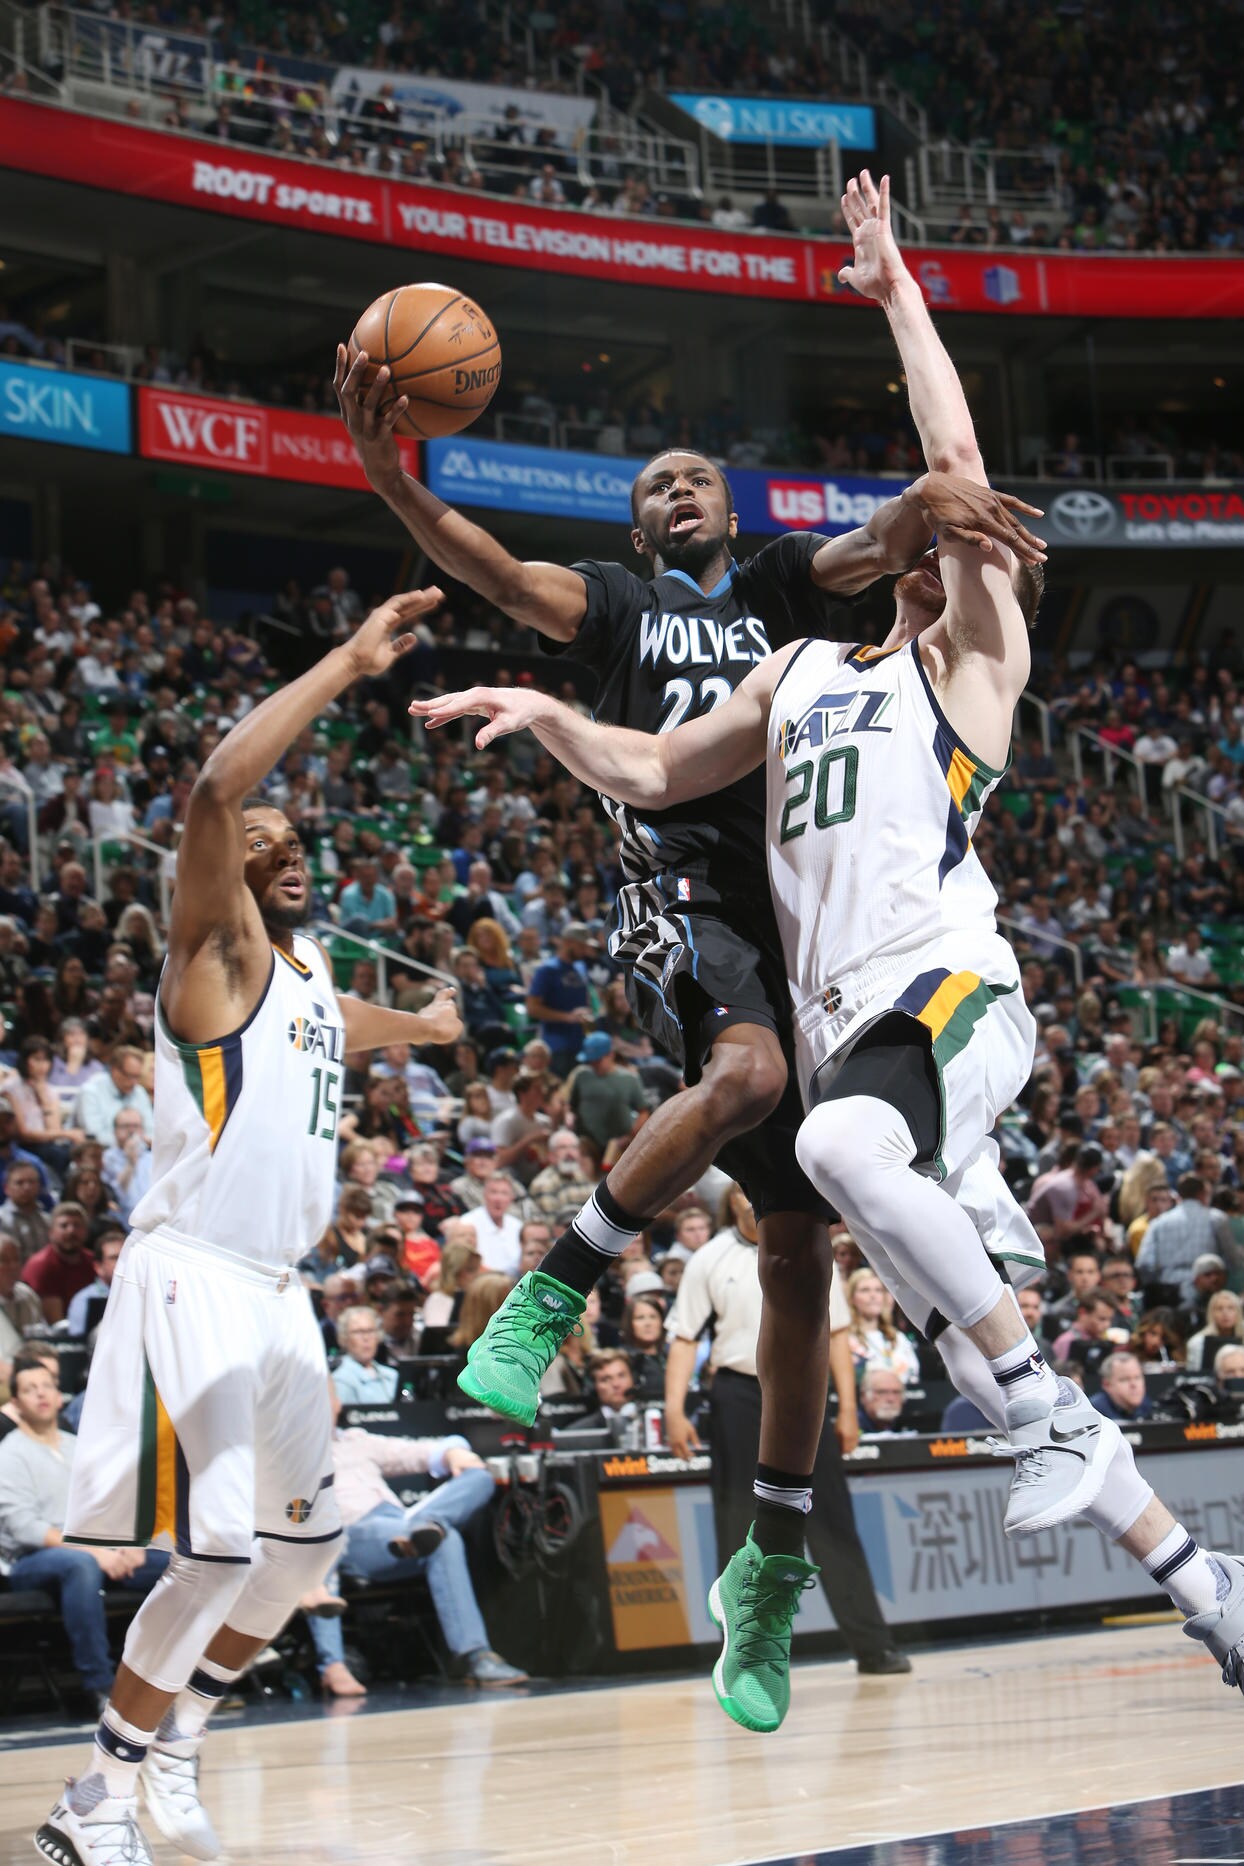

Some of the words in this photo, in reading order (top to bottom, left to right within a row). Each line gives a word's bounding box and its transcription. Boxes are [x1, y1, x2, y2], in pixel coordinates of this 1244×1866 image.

[193, 161, 275, 205] ROOT
[275, 184, 373, 225] SPORTS
[398, 203, 467, 240] YOUR
[469, 216, 610, 263] TELEVISION
[613, 238, 688, 273] HOME
[691, 247, 742, 278] FOR
[744, 254, 797, 283] THE
[4, 378, 100, 435] SKIN
[158, 402, 260, 460] WCF
[1120, 493, 1244, 521] TOYOTA
[639, 610, 773, 670] WOLVES
[780, 745, 859, 845] 20
[307, 1067, 339, 1141] 15
